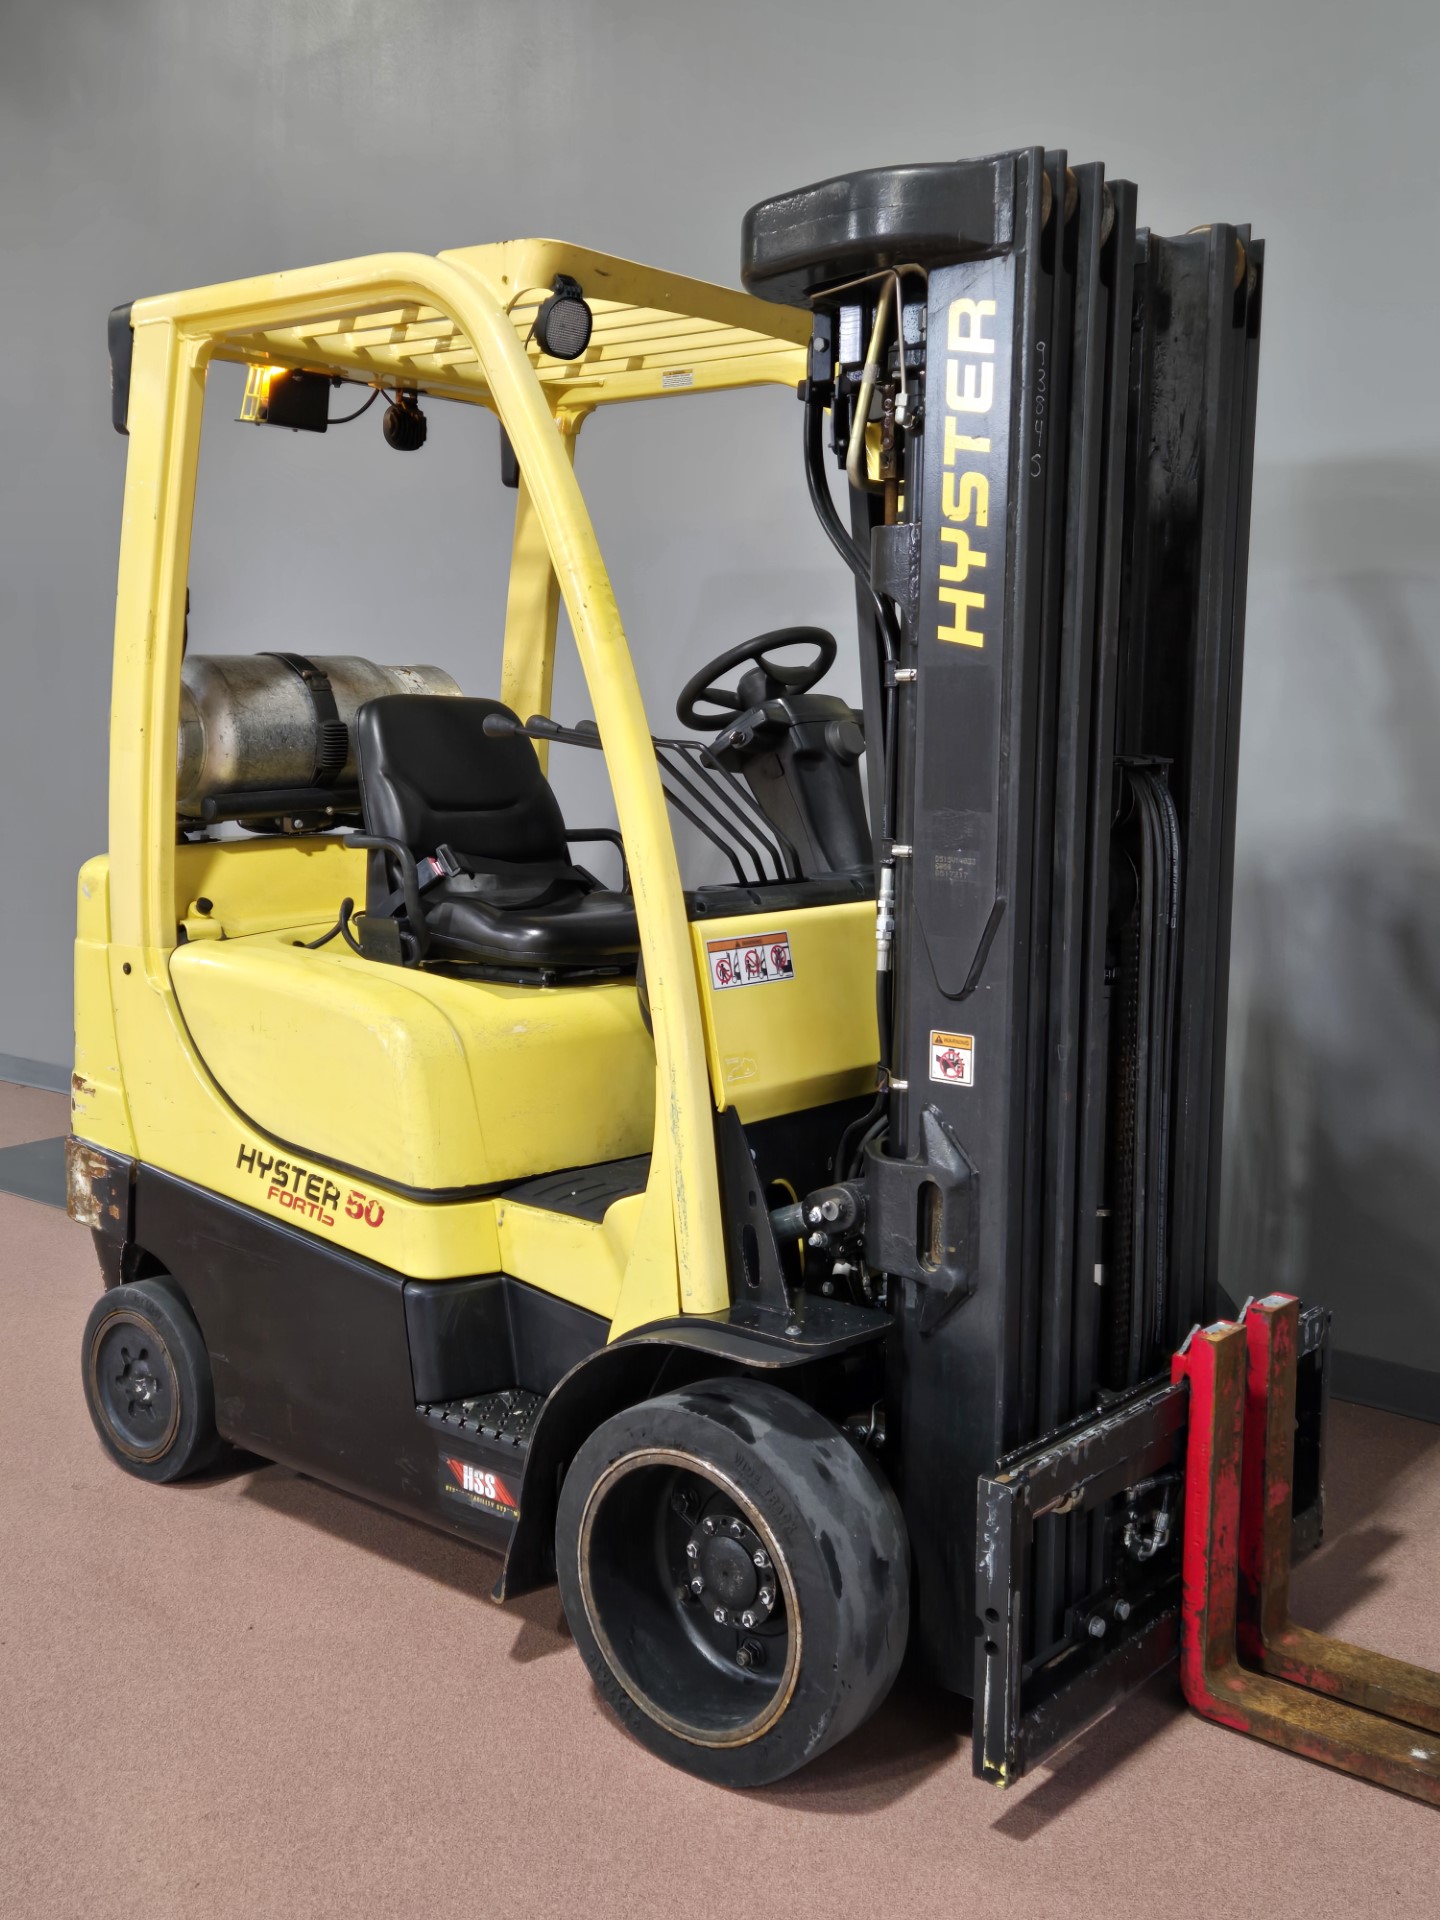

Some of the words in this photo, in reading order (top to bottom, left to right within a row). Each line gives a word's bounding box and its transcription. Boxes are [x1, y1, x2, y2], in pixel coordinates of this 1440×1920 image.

[937, 297, 997, 649] HYSTER
[236, 1143, 341, 1212] HYSTER
[345, 1189, 386, 1228] 50
[462, 1464, 497, 1499] HSS
